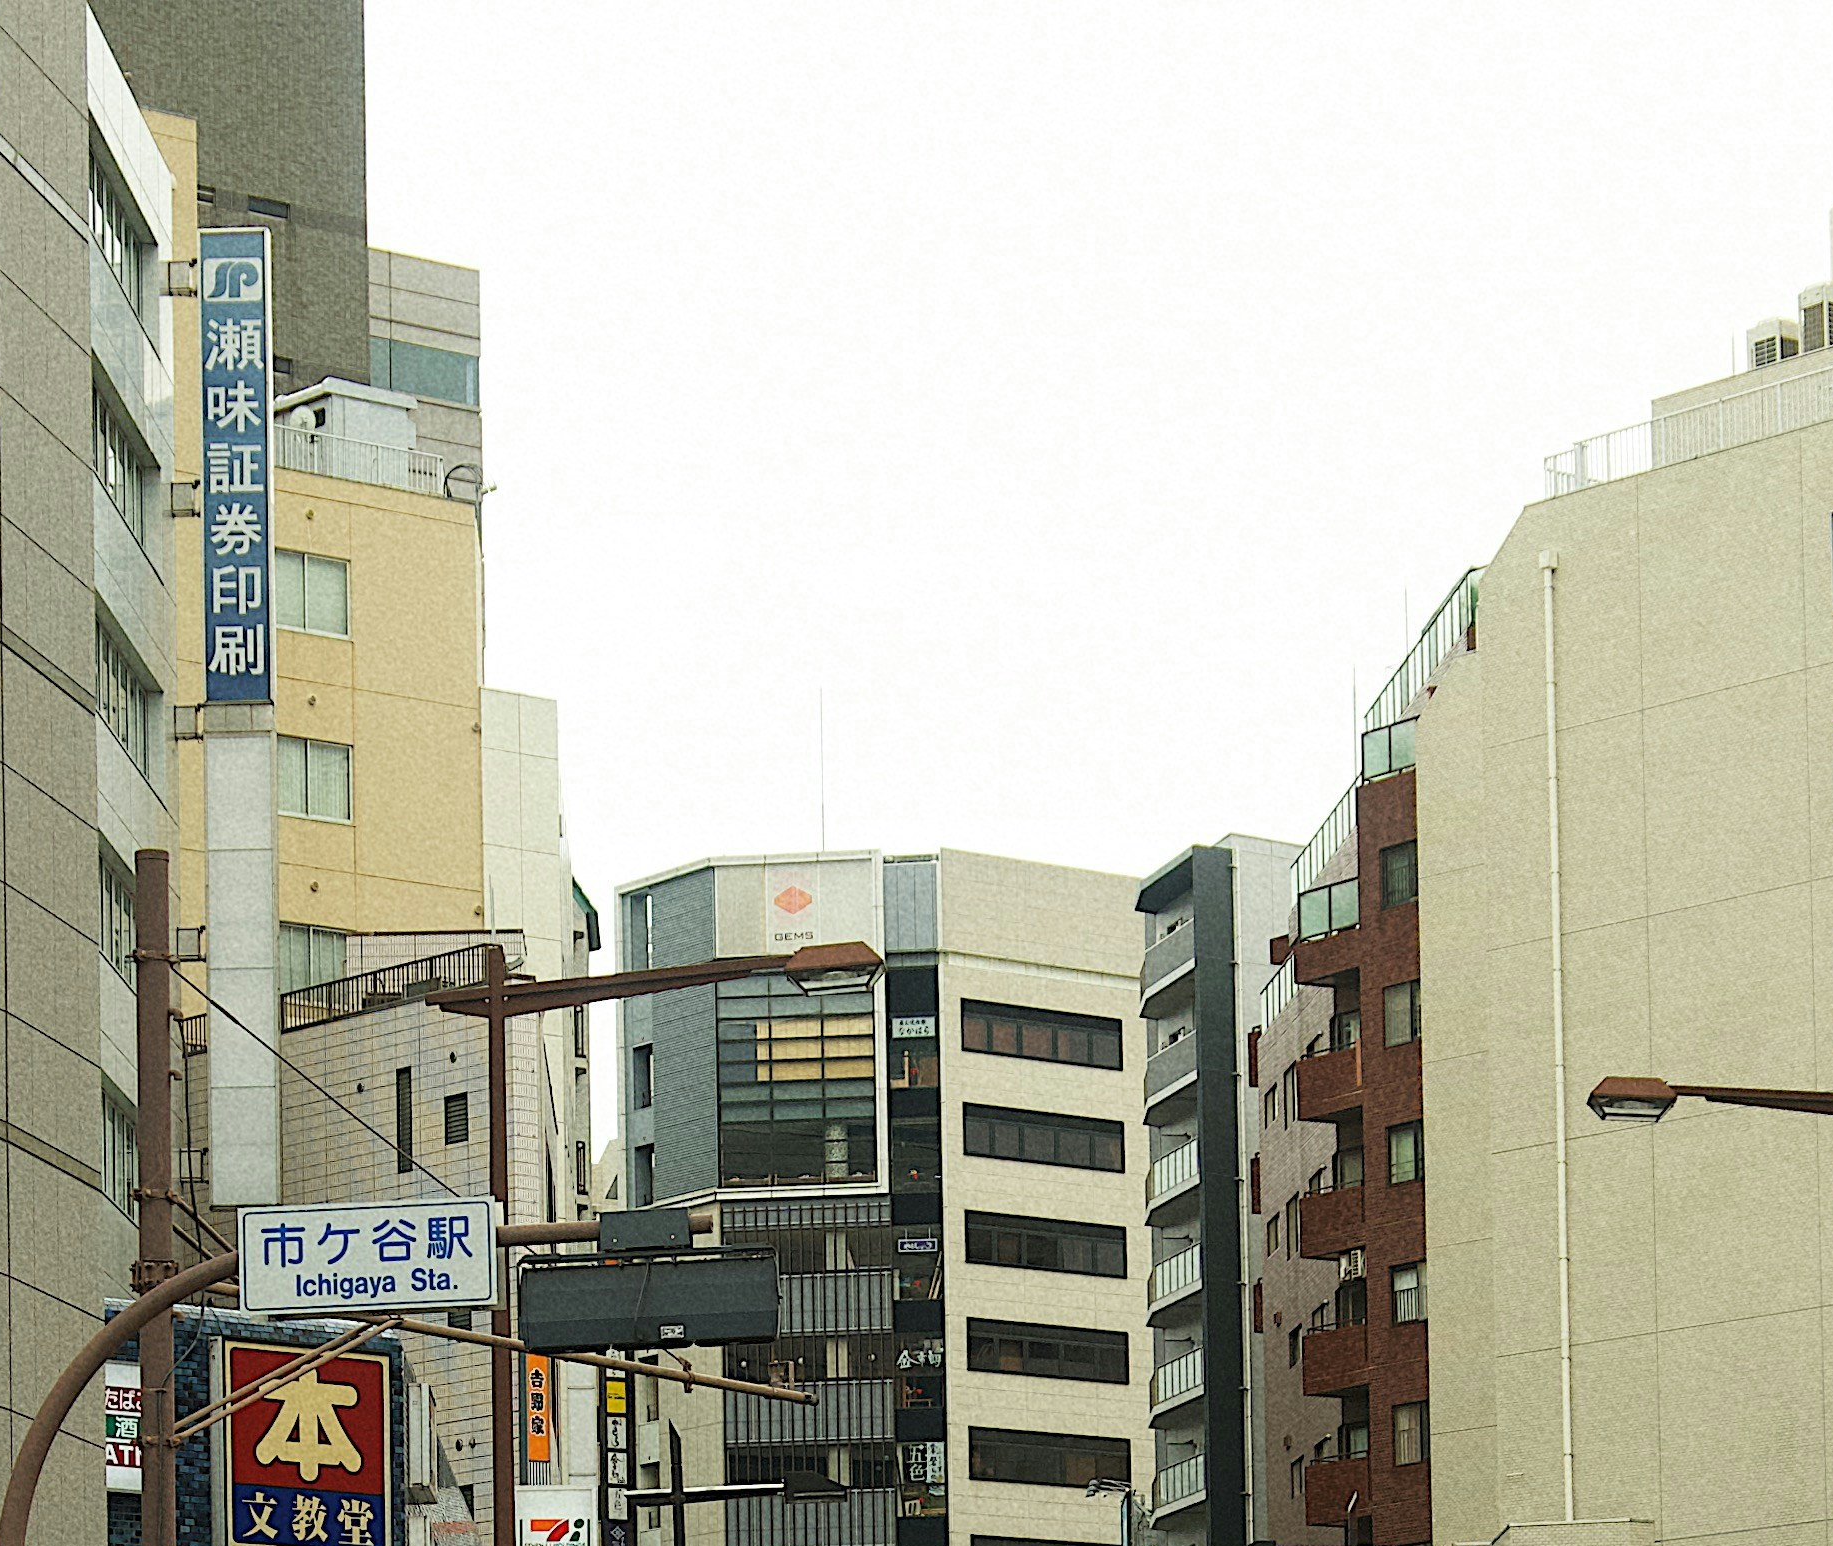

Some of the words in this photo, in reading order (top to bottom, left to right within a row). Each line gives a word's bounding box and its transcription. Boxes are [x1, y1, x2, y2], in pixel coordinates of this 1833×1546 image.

[206, 317, 265, 677] 瀬味証券印刷
[774, 931, 814, 940] GEMS
[296, 1272, 396, 1299] Ichigaya
[412, 1268, 459, 1293] Sta.
[115, 1416, 139, 1438] 酒
[255, 1368, 364, 1482] 本
[241, 1491, 375, 1546] 文教堂
